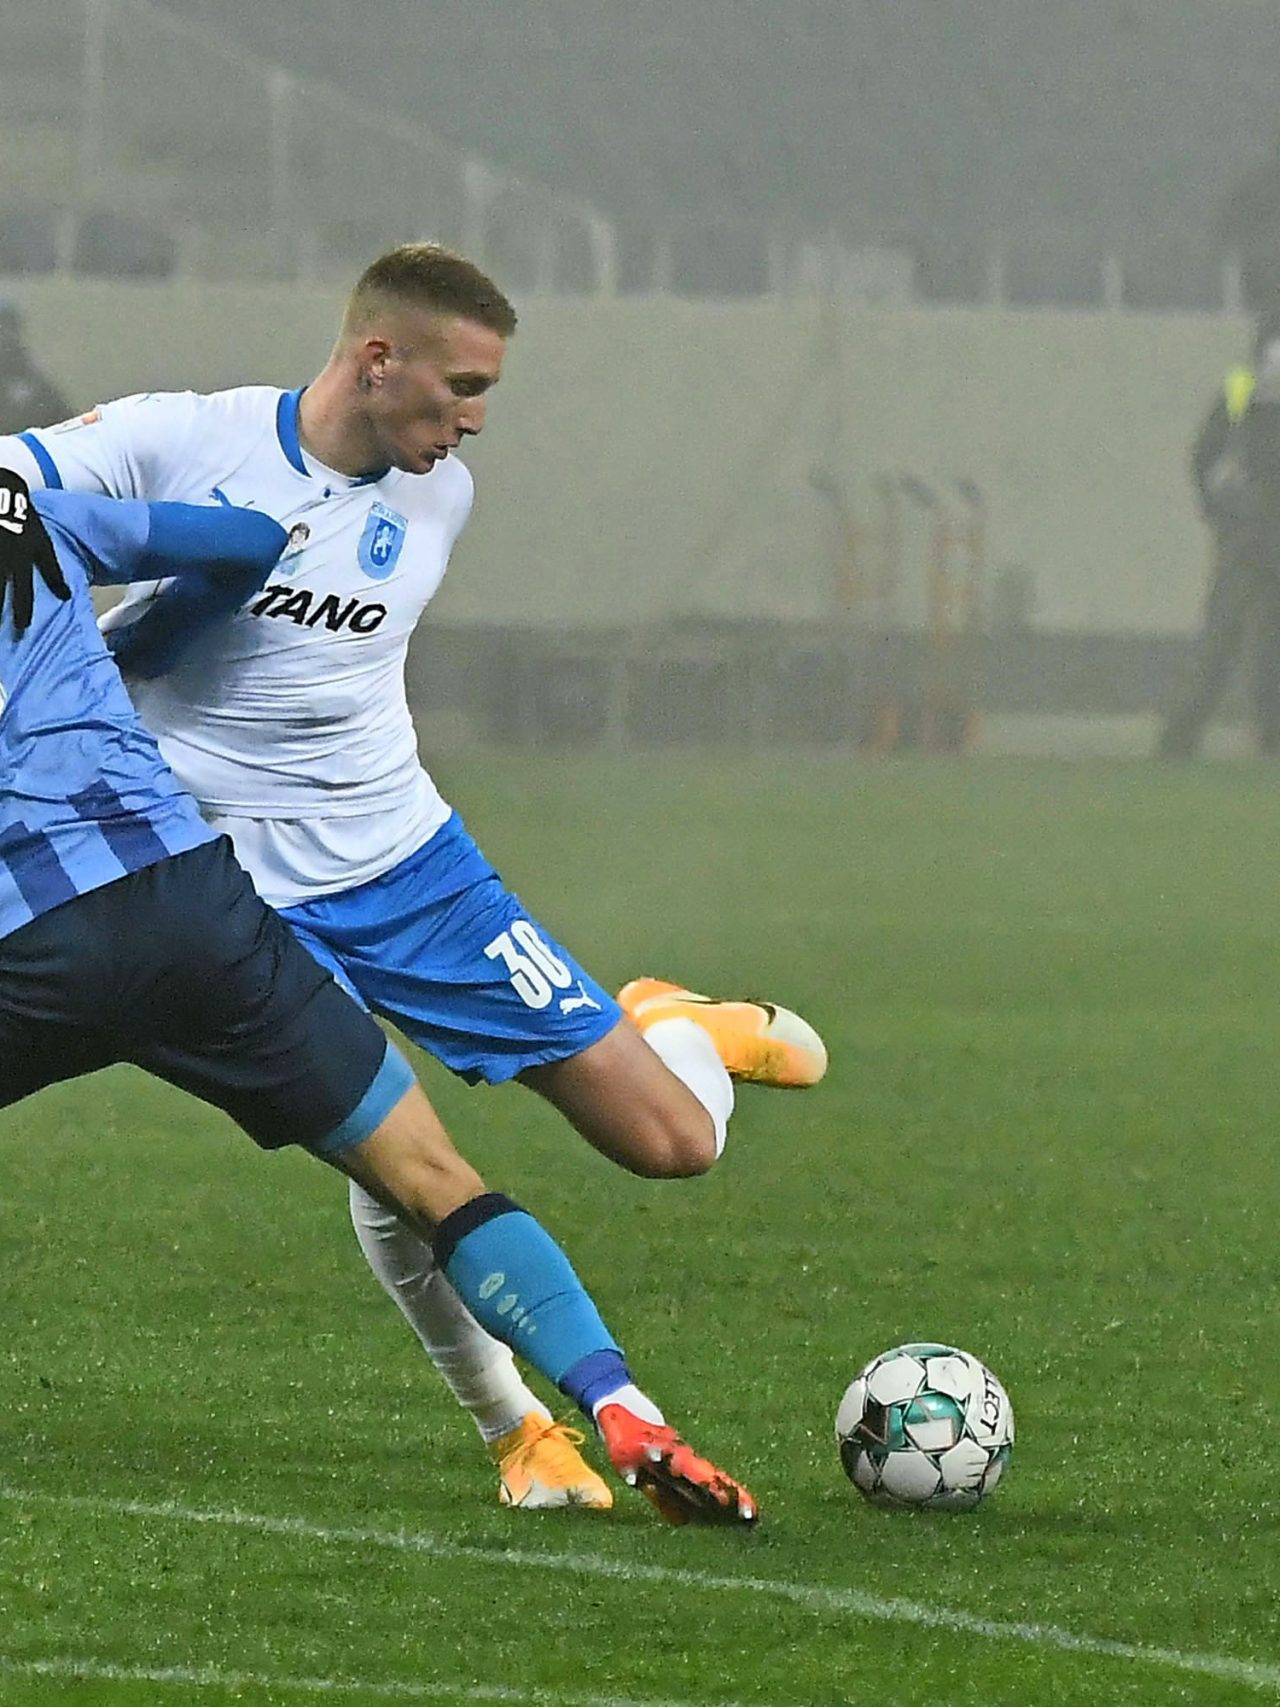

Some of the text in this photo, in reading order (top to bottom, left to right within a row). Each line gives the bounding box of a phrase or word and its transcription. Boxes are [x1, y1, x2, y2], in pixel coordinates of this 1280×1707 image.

[250, 584, 388, 634] TANO
[483, 919, 572, 1010] 30
[981, 1368, 1001, 1437] LECT
